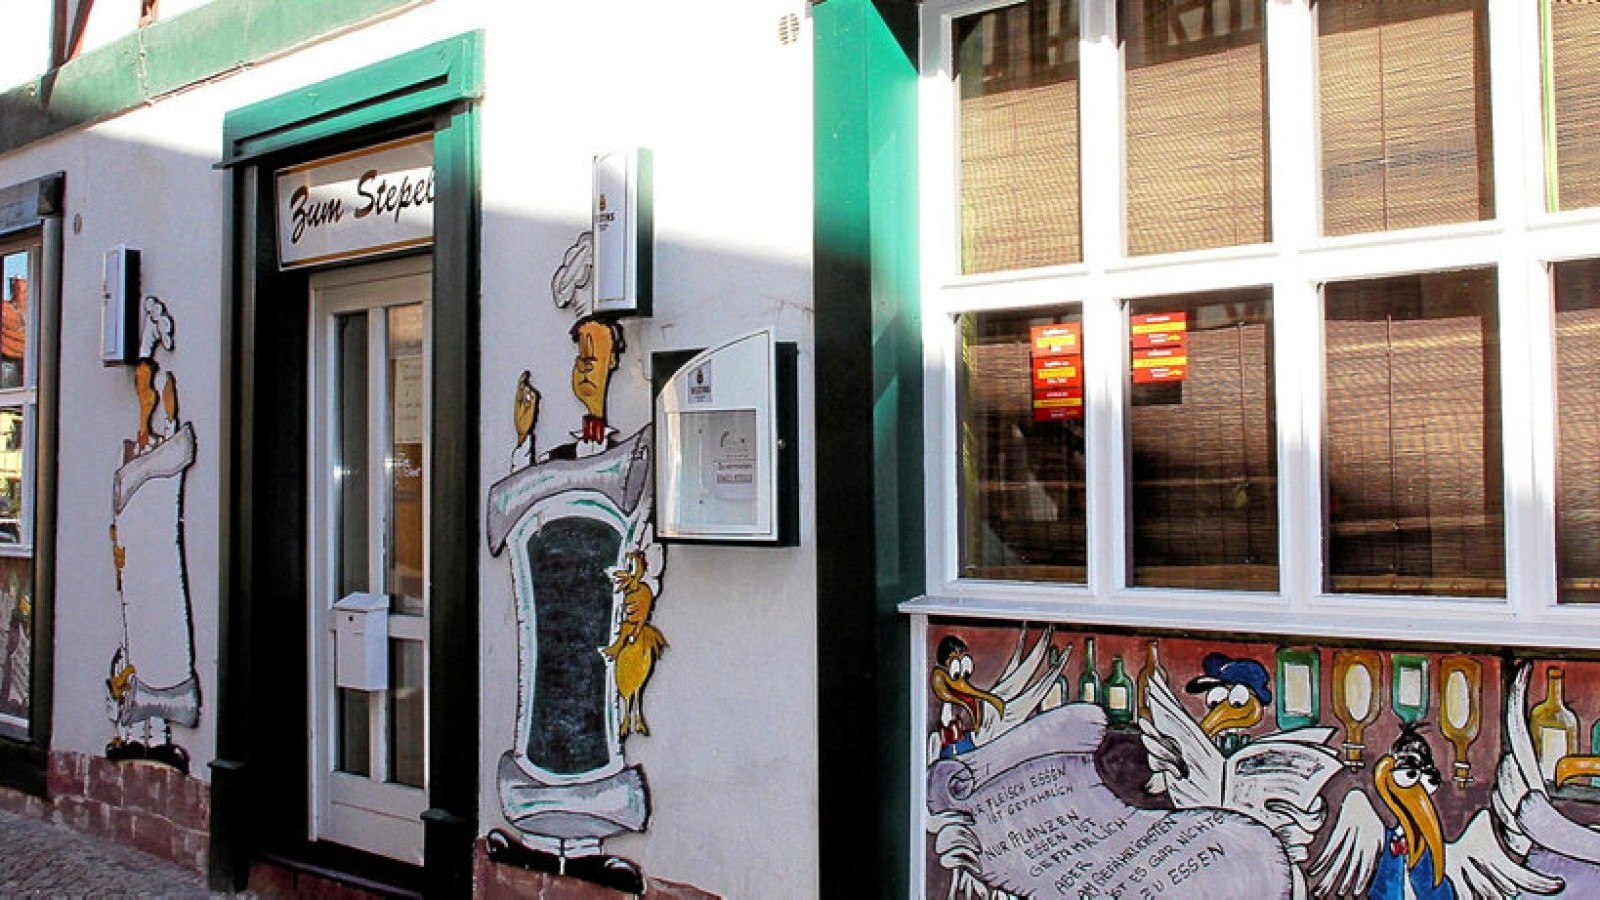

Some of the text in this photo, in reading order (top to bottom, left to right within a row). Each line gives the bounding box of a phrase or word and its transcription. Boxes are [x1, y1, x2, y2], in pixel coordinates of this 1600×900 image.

[290, 169, 434, 244] Zum Stepel
[1029, 765, 1066, 787] ESSEN
[984, 841, 1009, 861] NUR
[1024, 832, 1068, 860] ESSEN
[1055, 861, 1093, 895] ABER
[1129, 867, 1147, 883] ES
[1149, 845, 1180, 868] GAR
[1168, 842, 1225, 885] ESSEN
[1078, 882, 1101, 900] AM
